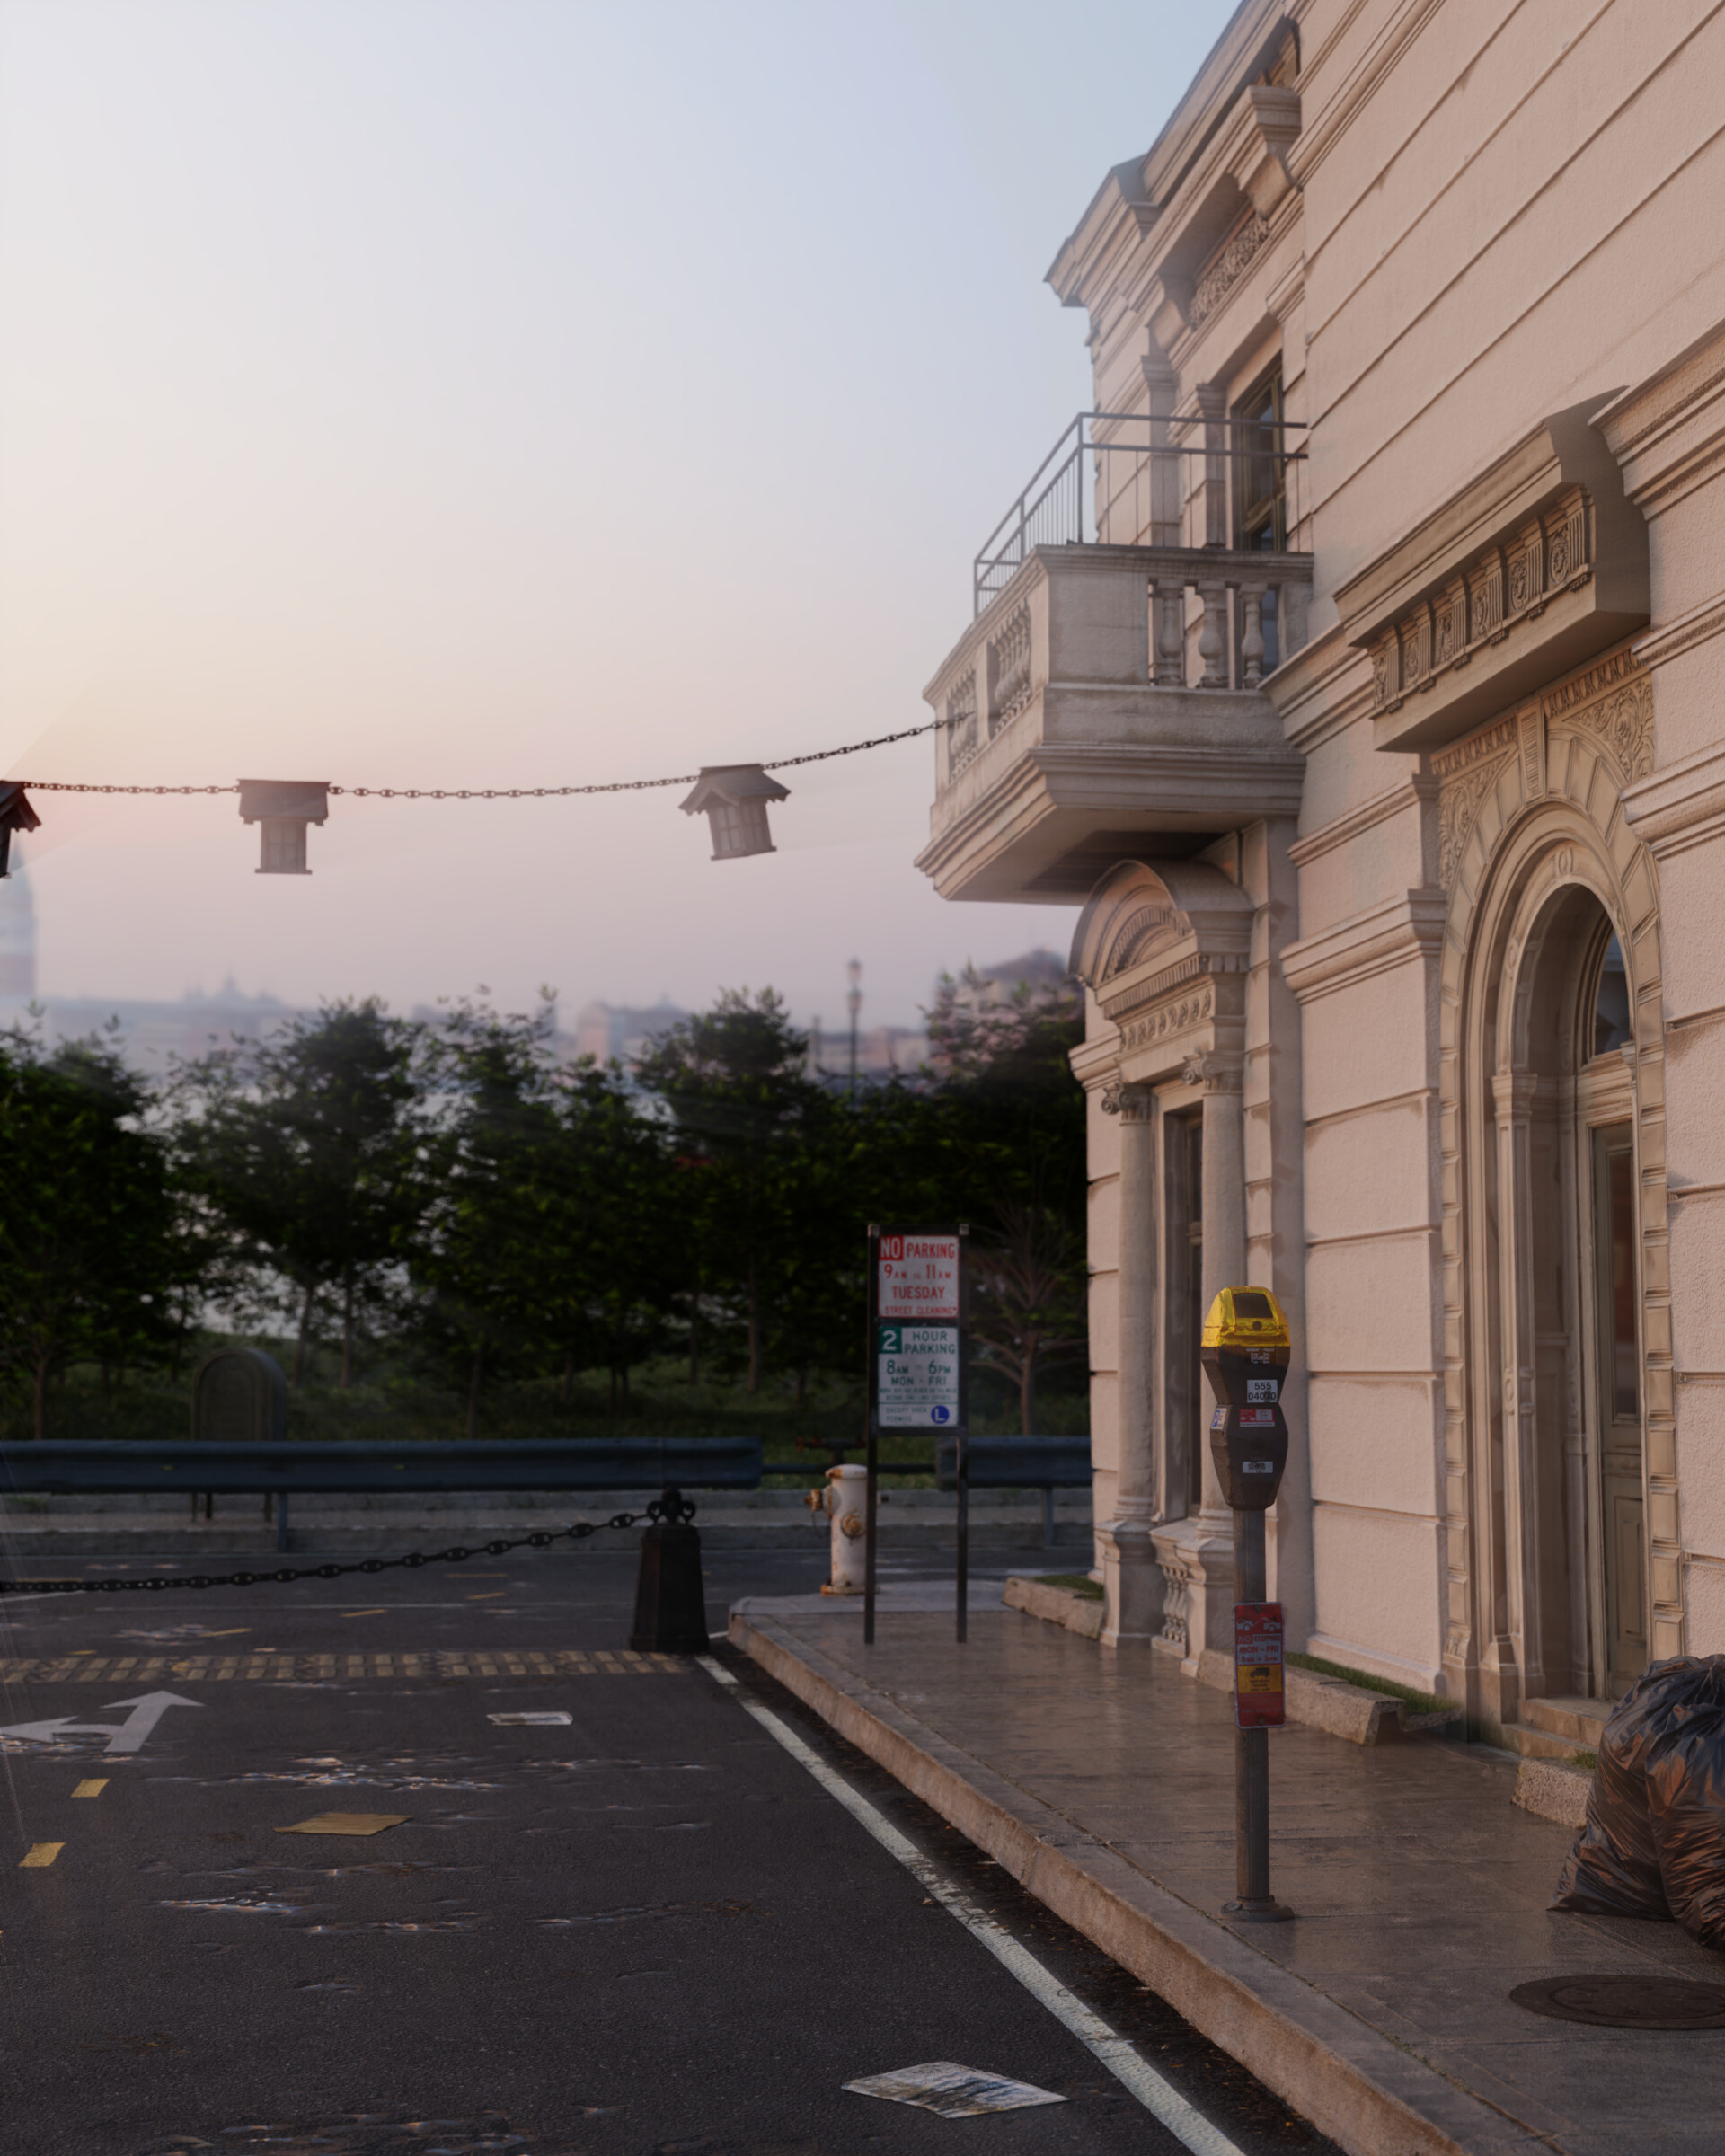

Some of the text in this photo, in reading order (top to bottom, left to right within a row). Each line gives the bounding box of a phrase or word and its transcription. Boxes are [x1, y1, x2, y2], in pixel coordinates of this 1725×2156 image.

[880, 1236, 955, 1259] NO PARKING
[892, 1286, 945, 1299] TUESDAY
[885, 1305, 912, 1315] STREET
[882, 1329, 898, 1351] 2
[913, 1330, 948, 1342] HOUR
[905, 1343, 956, 1355] PARKING
[891, 1376, 914, 1386] MON
[928, 1376, 946, 1386] FRI
[1254, 1382, 1272, 1390] 555
[934, 1409, 946, 1422] L
[1239, 1645, 1259, 1654] MON
[1266, 1645, 1279, 1653] FRI
